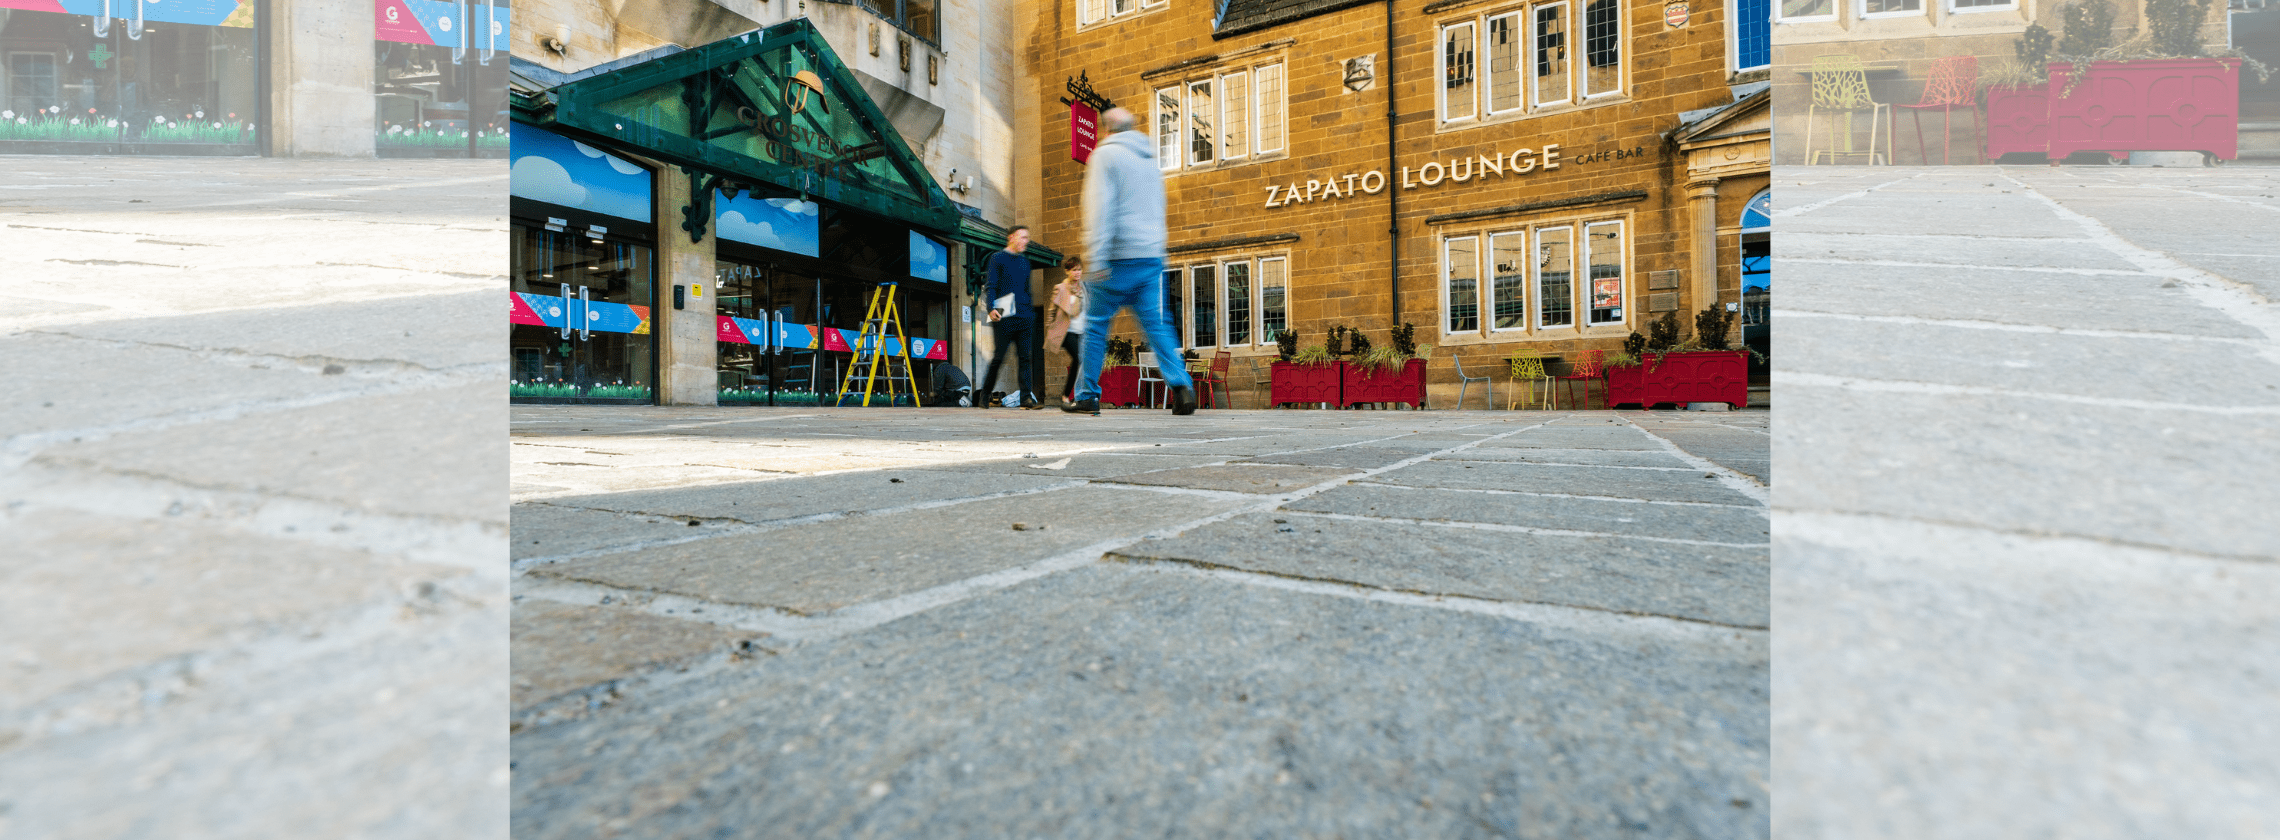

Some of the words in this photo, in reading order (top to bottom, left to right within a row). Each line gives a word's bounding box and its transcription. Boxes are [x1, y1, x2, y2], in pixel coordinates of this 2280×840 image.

[737, 105, 870, 168] GROSVENOR
[1077, 126, 1095, 140] LOUNGE
[1078, 115, 1094, 129] ZAPATO
[765, 139, 848, 182] CENTRE
[1575, 149, 1611, 166] CAFÉ
[1616, 146, 1644, 160] BAR
[1264, 170, 1386, 209] ZAPATO
[1402, 143, 1560, 190] LOUNGE
